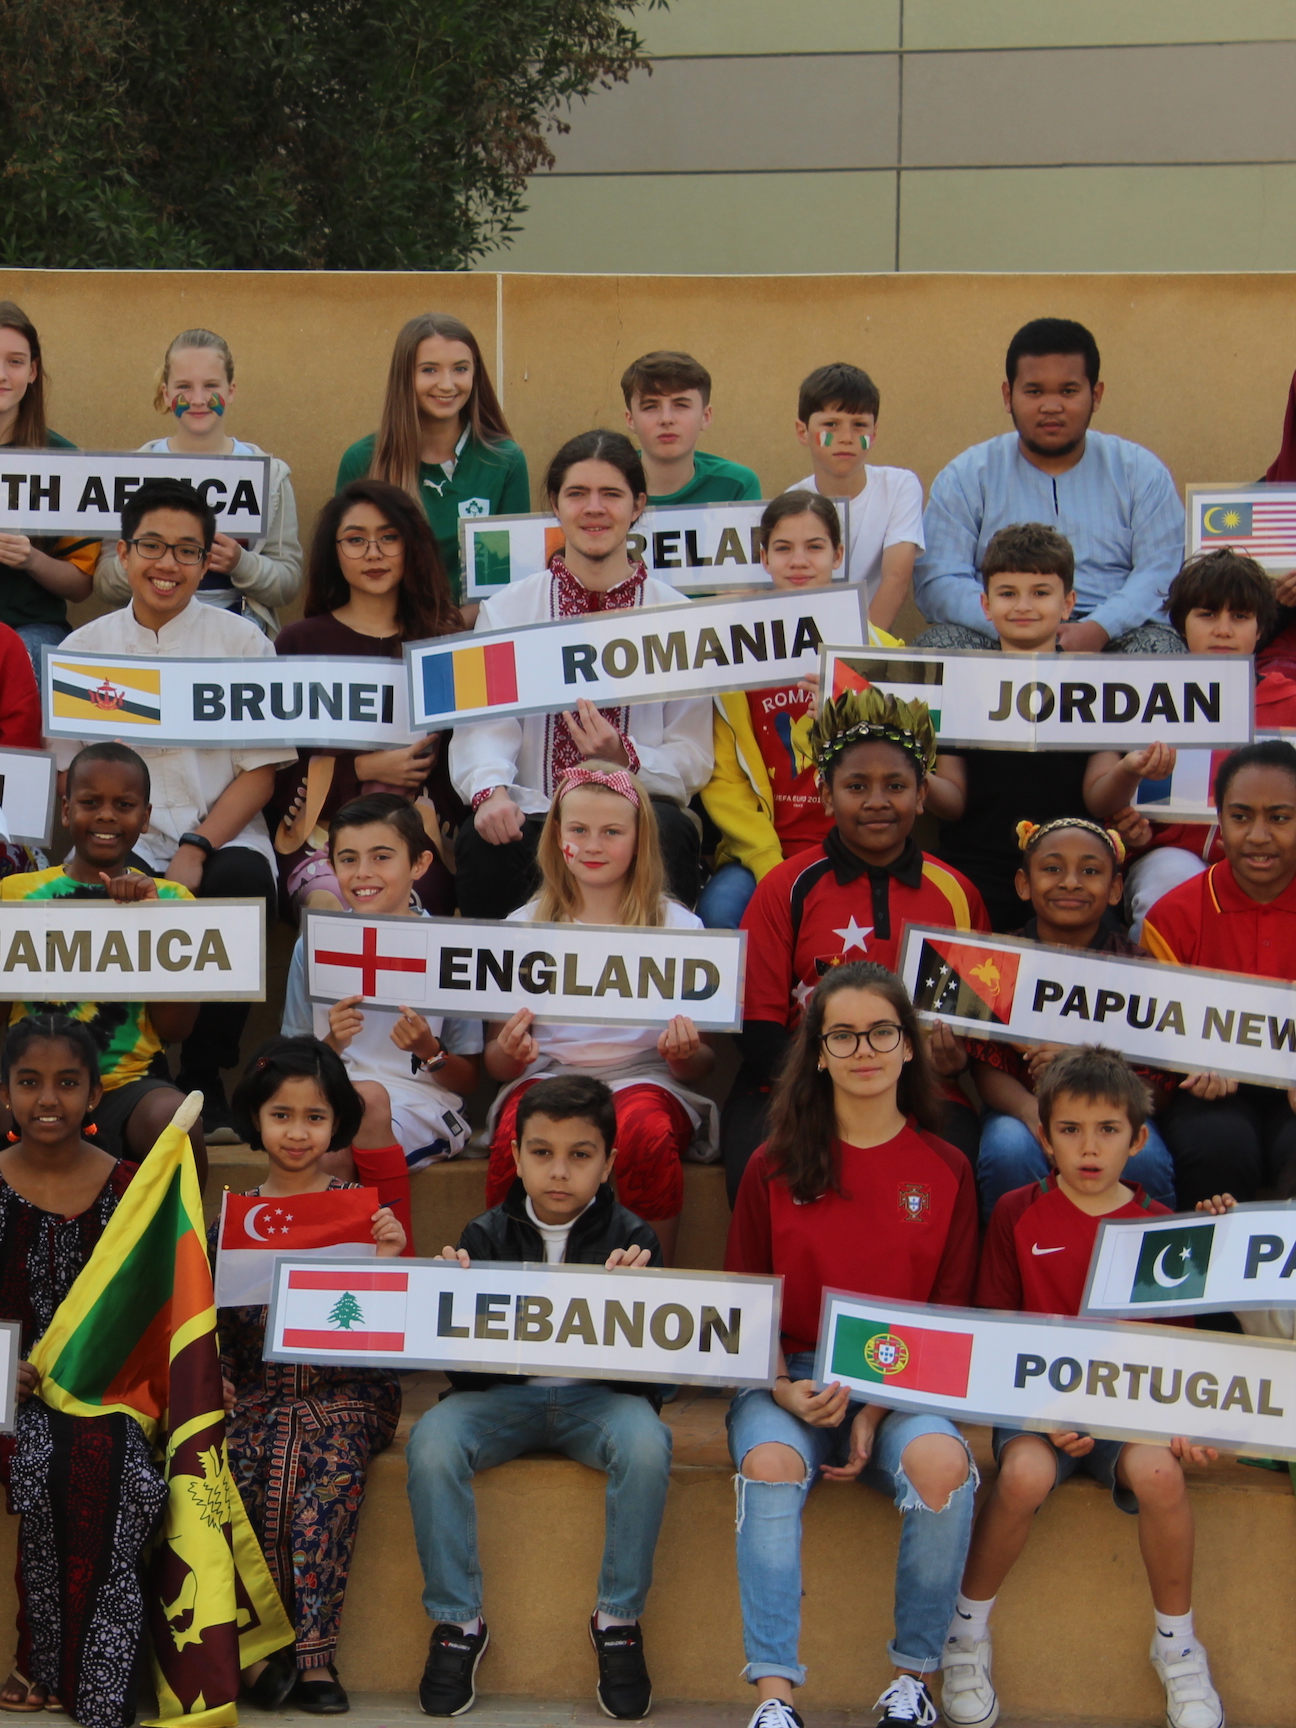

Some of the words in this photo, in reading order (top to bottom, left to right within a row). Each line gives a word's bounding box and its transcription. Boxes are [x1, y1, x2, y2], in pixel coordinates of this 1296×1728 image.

[77, 475, 261, 516] AFCA
[626, 526, 762, 570] RELA
[561, 616, 823, 685] ROMANIA
[192, 683, 394, 724] BRUNEI
[987, 681, 1221, 723] JORDAN
[807, 796, 821, 804] 201
[438, 947, 720, 1001] ENGLAND
[1032, 979, 1186, 1036] PAPUA
[438, 1291, 742, 1354] LEBANON
[1013, 1353, 1284, 1417] PORTUGAL
